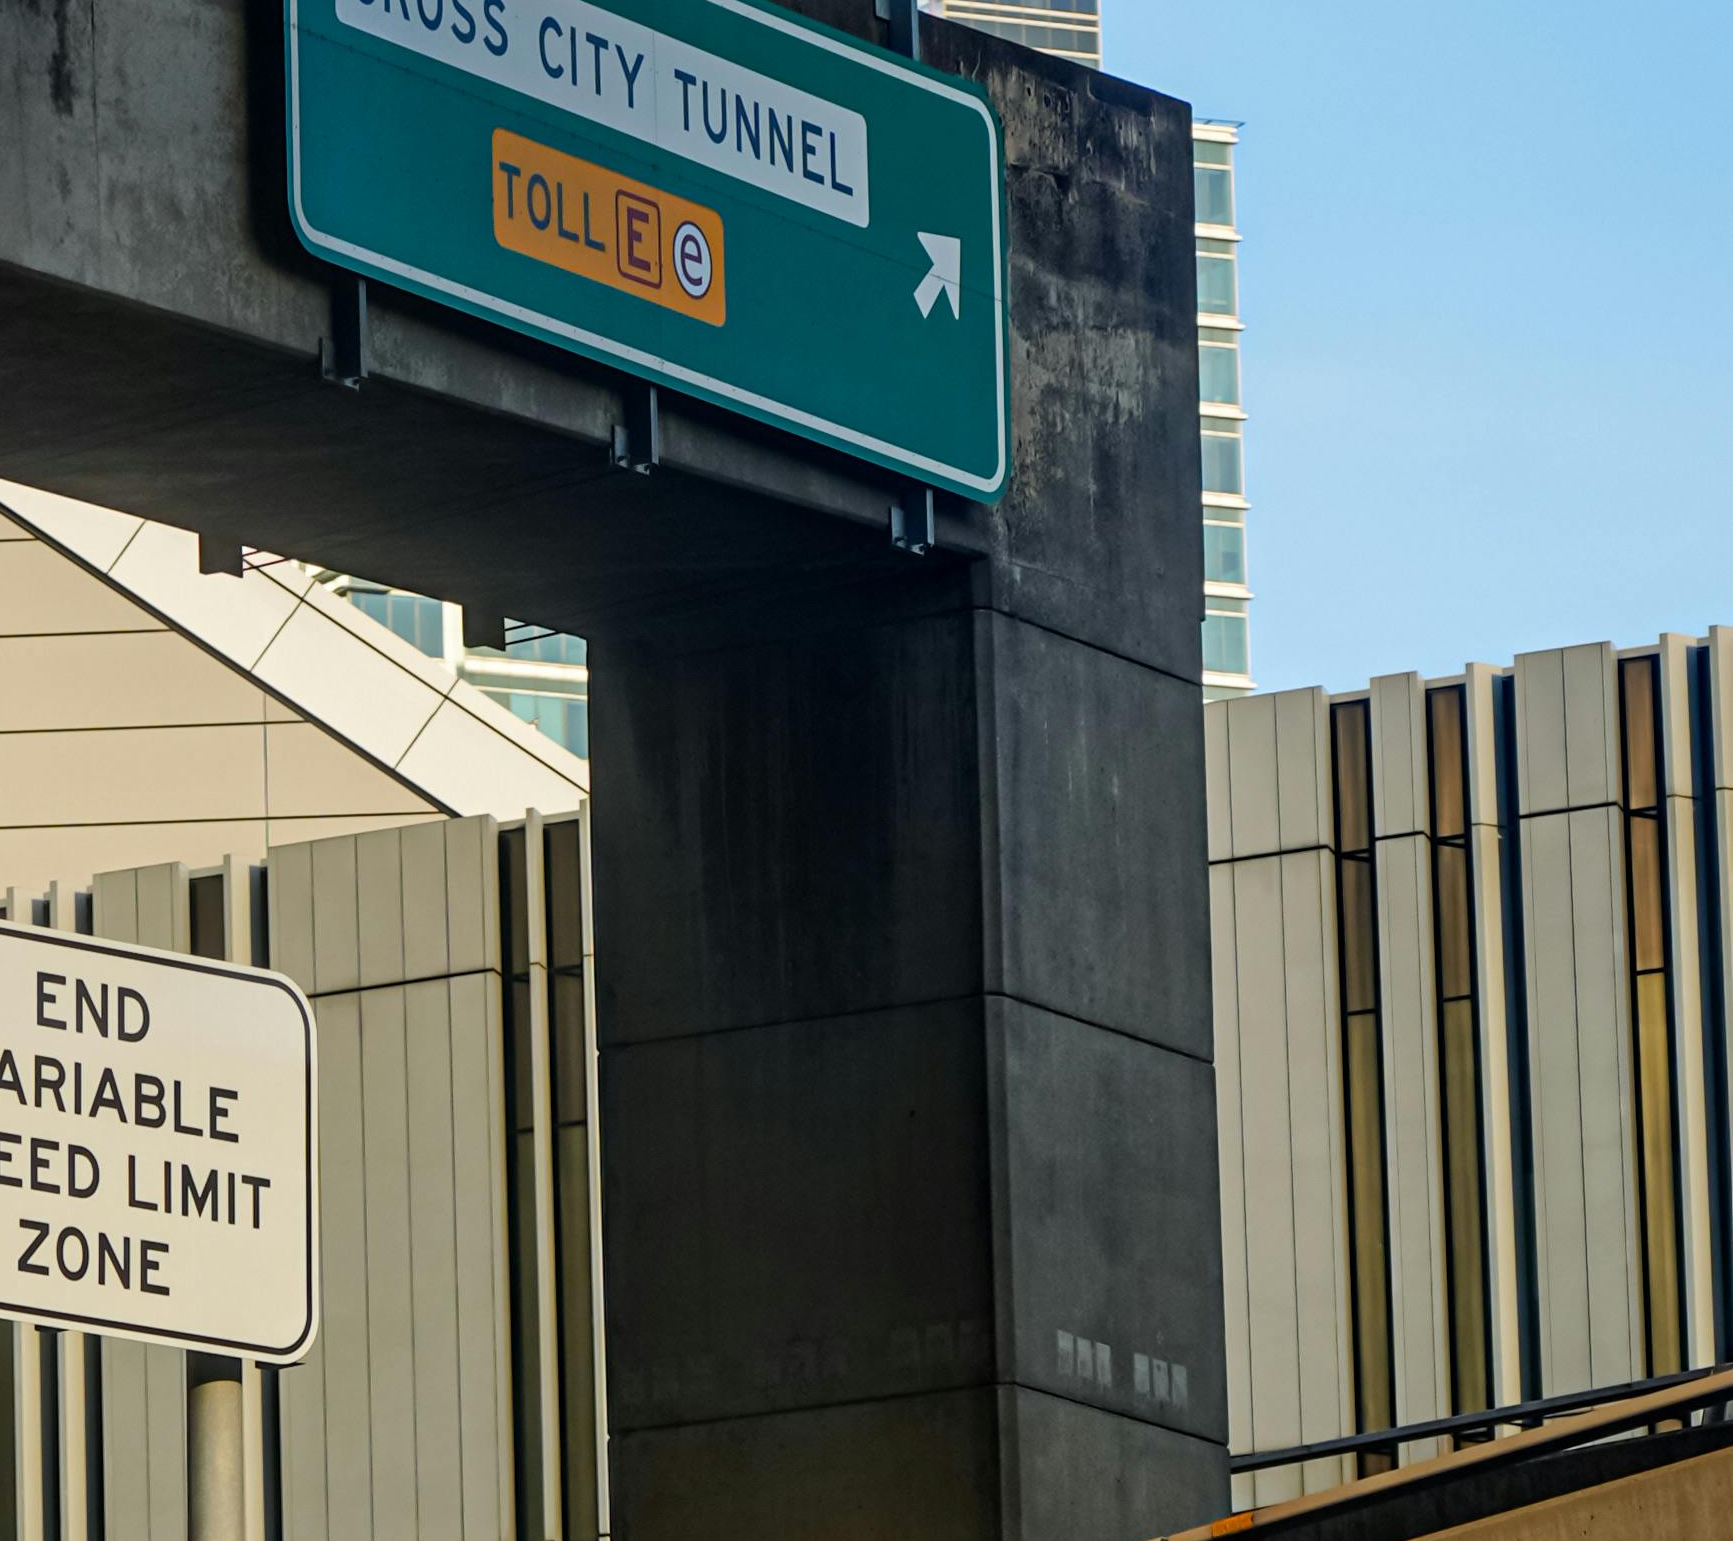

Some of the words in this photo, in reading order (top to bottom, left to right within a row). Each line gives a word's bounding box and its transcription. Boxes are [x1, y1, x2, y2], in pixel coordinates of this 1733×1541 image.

[538, 15, 645, 110] CITY
[674, 68, 854, 198] TUNNEL
[498, 160, 608, 254] TOLL
[626, 205, 652, 274] E
[36, 970, 151, 1043] END
[127, 1154, 271, 1230] LIMIT
[17, 1218, 171, 1297] ZONE
